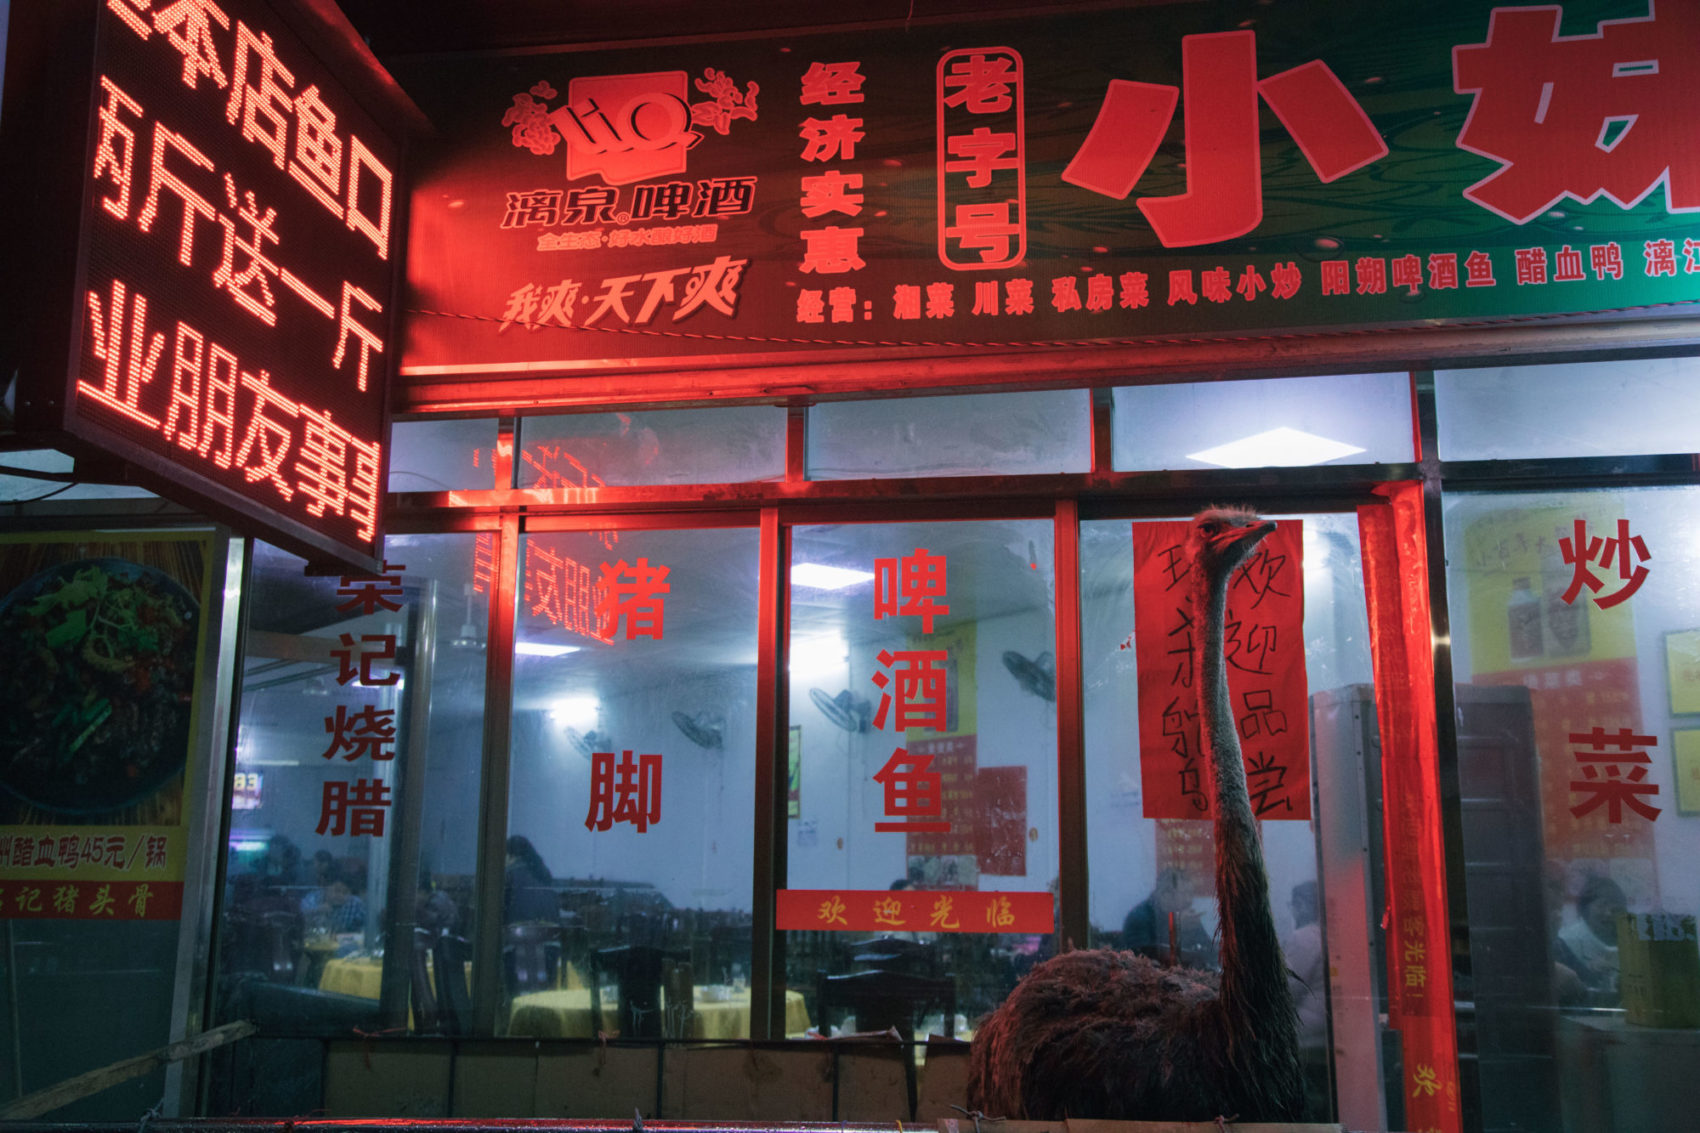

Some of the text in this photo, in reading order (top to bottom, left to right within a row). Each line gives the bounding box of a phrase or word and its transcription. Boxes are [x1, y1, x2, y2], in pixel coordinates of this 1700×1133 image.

[799, 61, 866, 274] 经济实惠
[944, 53, 1019, 263] 老字号
[893, 282, 955, 319] 湘菜
[971, 278, 1034, 316] 川菜
[1051, 271, 1150, 313] 私房菜
[1167, 261, 1302, 306] 风味小炒
[1320, 250, 1496, 296] 阳朔啤酒鱼
[1514, 242, 1623, 286] 醋血鸭
[315, 560, 406, 838] 荣记烧腊
[584, 557, 671, 834] 猪脚
[872, 548, 952, 834] 啤酒鱼
[1223, 548, 1293, 817] 欢迎品尝
[1558, 518, 1663, 824] 炒菜
[0, 884, 154, 918] 记猪头骨
[817, 895, 1016, 929] 欢迎光临
